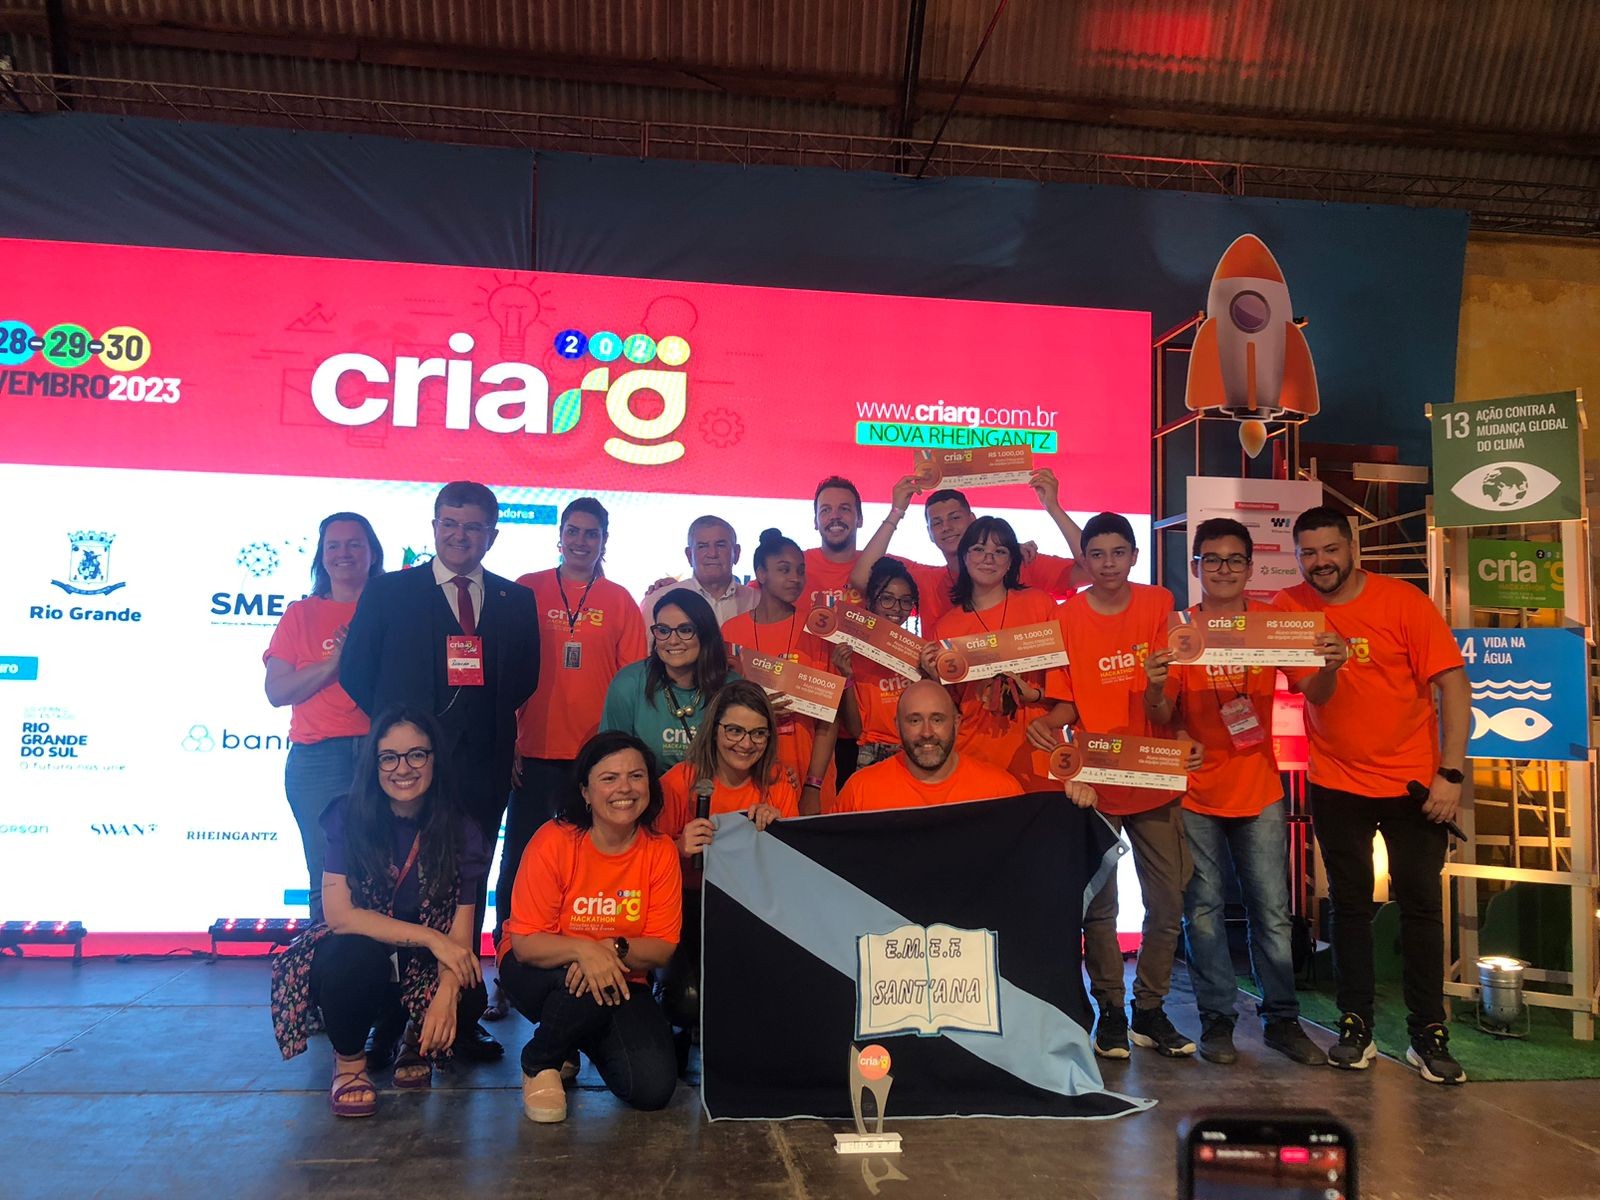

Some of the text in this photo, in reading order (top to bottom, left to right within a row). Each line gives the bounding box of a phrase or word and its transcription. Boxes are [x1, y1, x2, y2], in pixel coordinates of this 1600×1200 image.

[311, 333, 687, 465] criarg
[856, 400, 1058, 428] www.criarg.com.br
[1476, 403, 1556, 422] AÇÃO CONTRA A
[1441, 411, 1470, 440] 13
[1477, 418, 1568, 437] MUDANÇA GLOBAL
[870, 424, 1050, 450] NOVA RHEINGANTZ
[1477, 438, 1525, 452] DO CLIMA
[210, 592, 285, 616] SME
[30, 605, 142, 622] Rio Grande
[1208, 617, 1246, 631] criarg
[1454, 637, 1477, 664] 4
[1483, 637, 1526, 648] VIDA NA
[1483, 650, 1513, 664] ÁGUA
[22, 722, 49, 733] RIO
[21, 734, 88, 745] GRANDE
[1088, 739, 1122, 753] criarg
[20, 746, 78, 757] DO SUL
[1058, 753, 1072, 769] 3
[90, 823, 144, 836] SWAN
[186, 831, 278, 841] RHEINGANTZ
[573, 891, 641, 922] criarg
[570, 915, 616, 923] HACKATHON
[873, 978, 981, 1005] SANT'ANA
